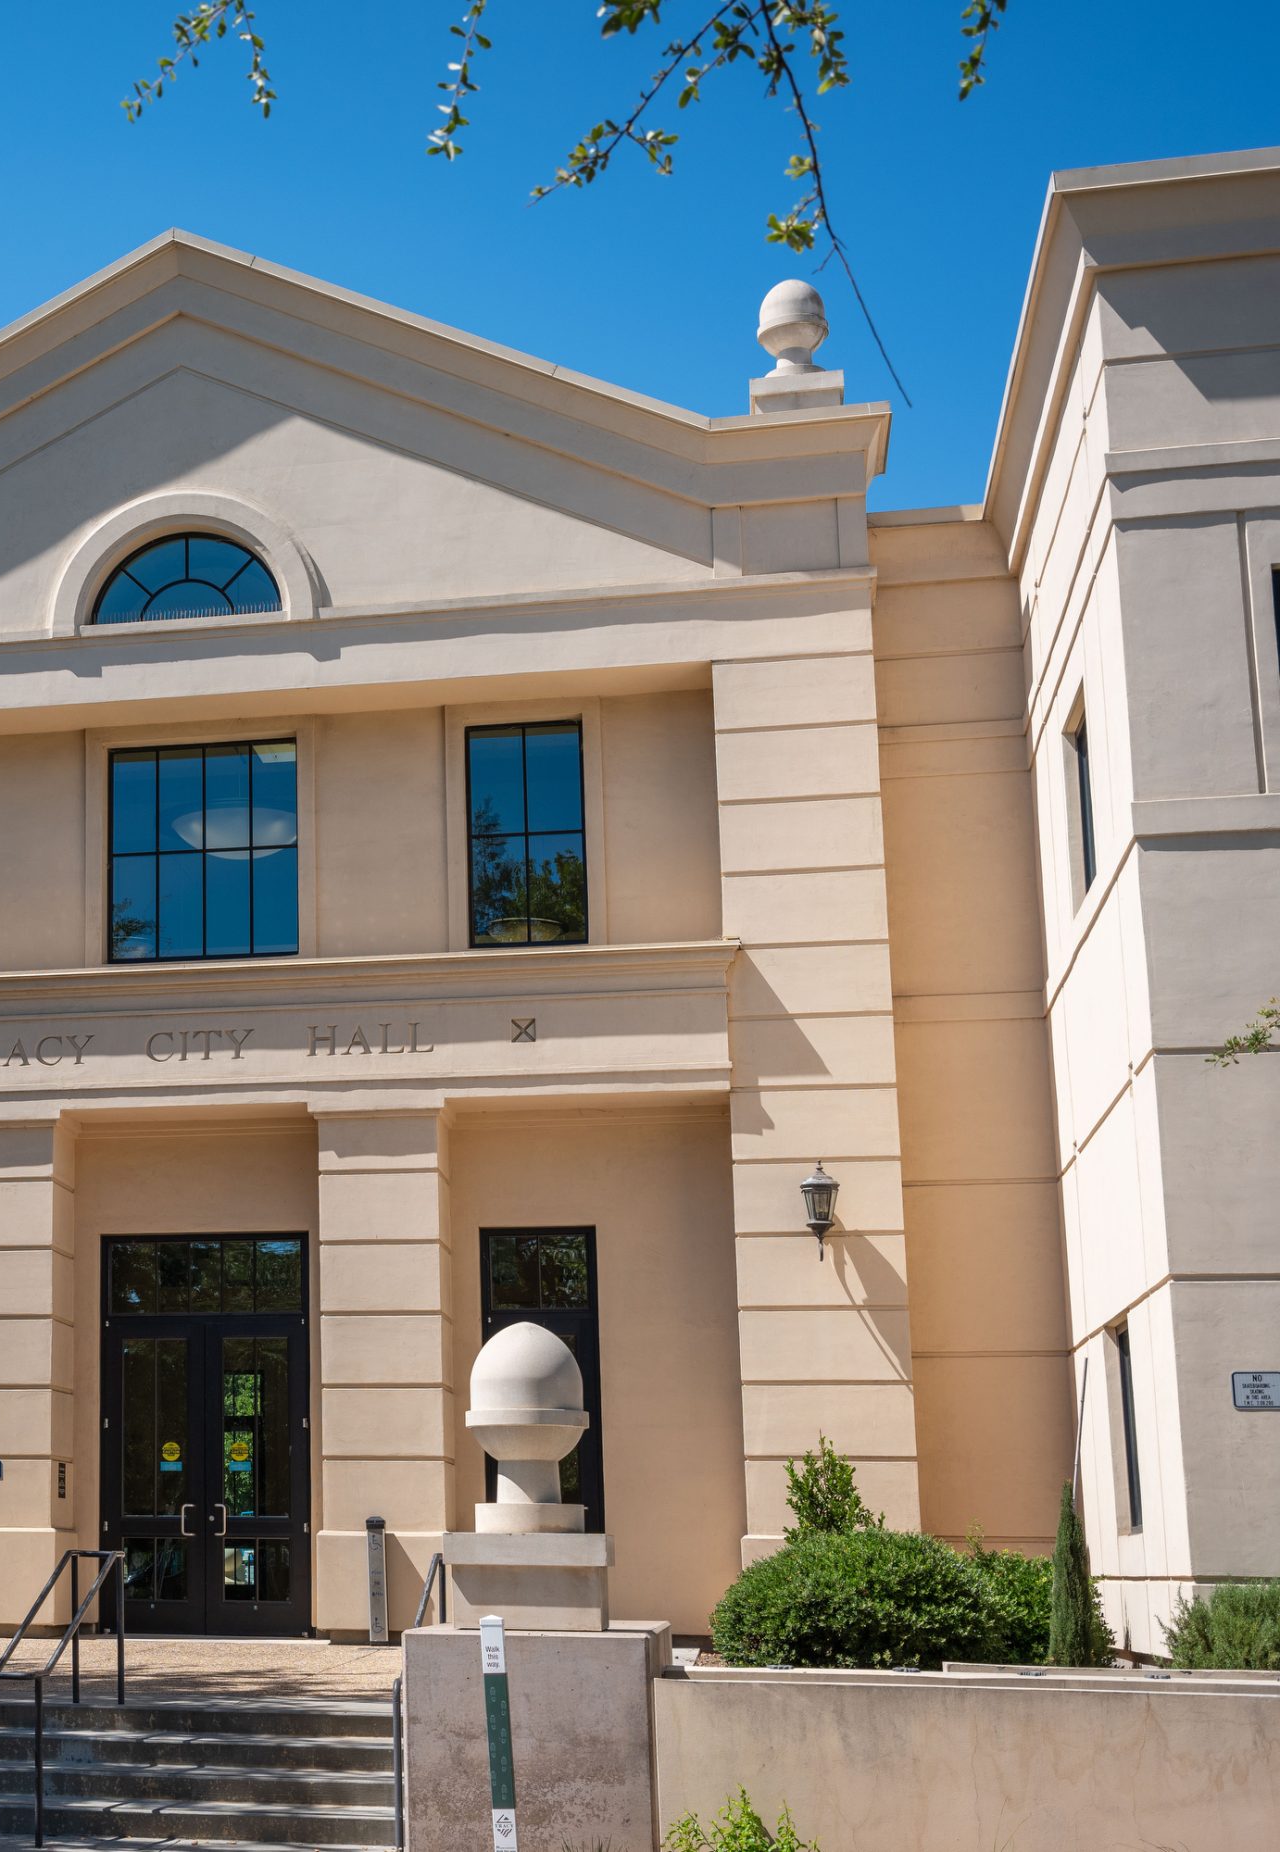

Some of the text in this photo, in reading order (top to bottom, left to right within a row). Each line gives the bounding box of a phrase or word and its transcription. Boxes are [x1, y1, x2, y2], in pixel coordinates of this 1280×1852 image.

[145, 1028, 255, 1062] CITY
[306, 1022, 434, 1057] HALL
[1252, 1374, 1263, 1382] NO
